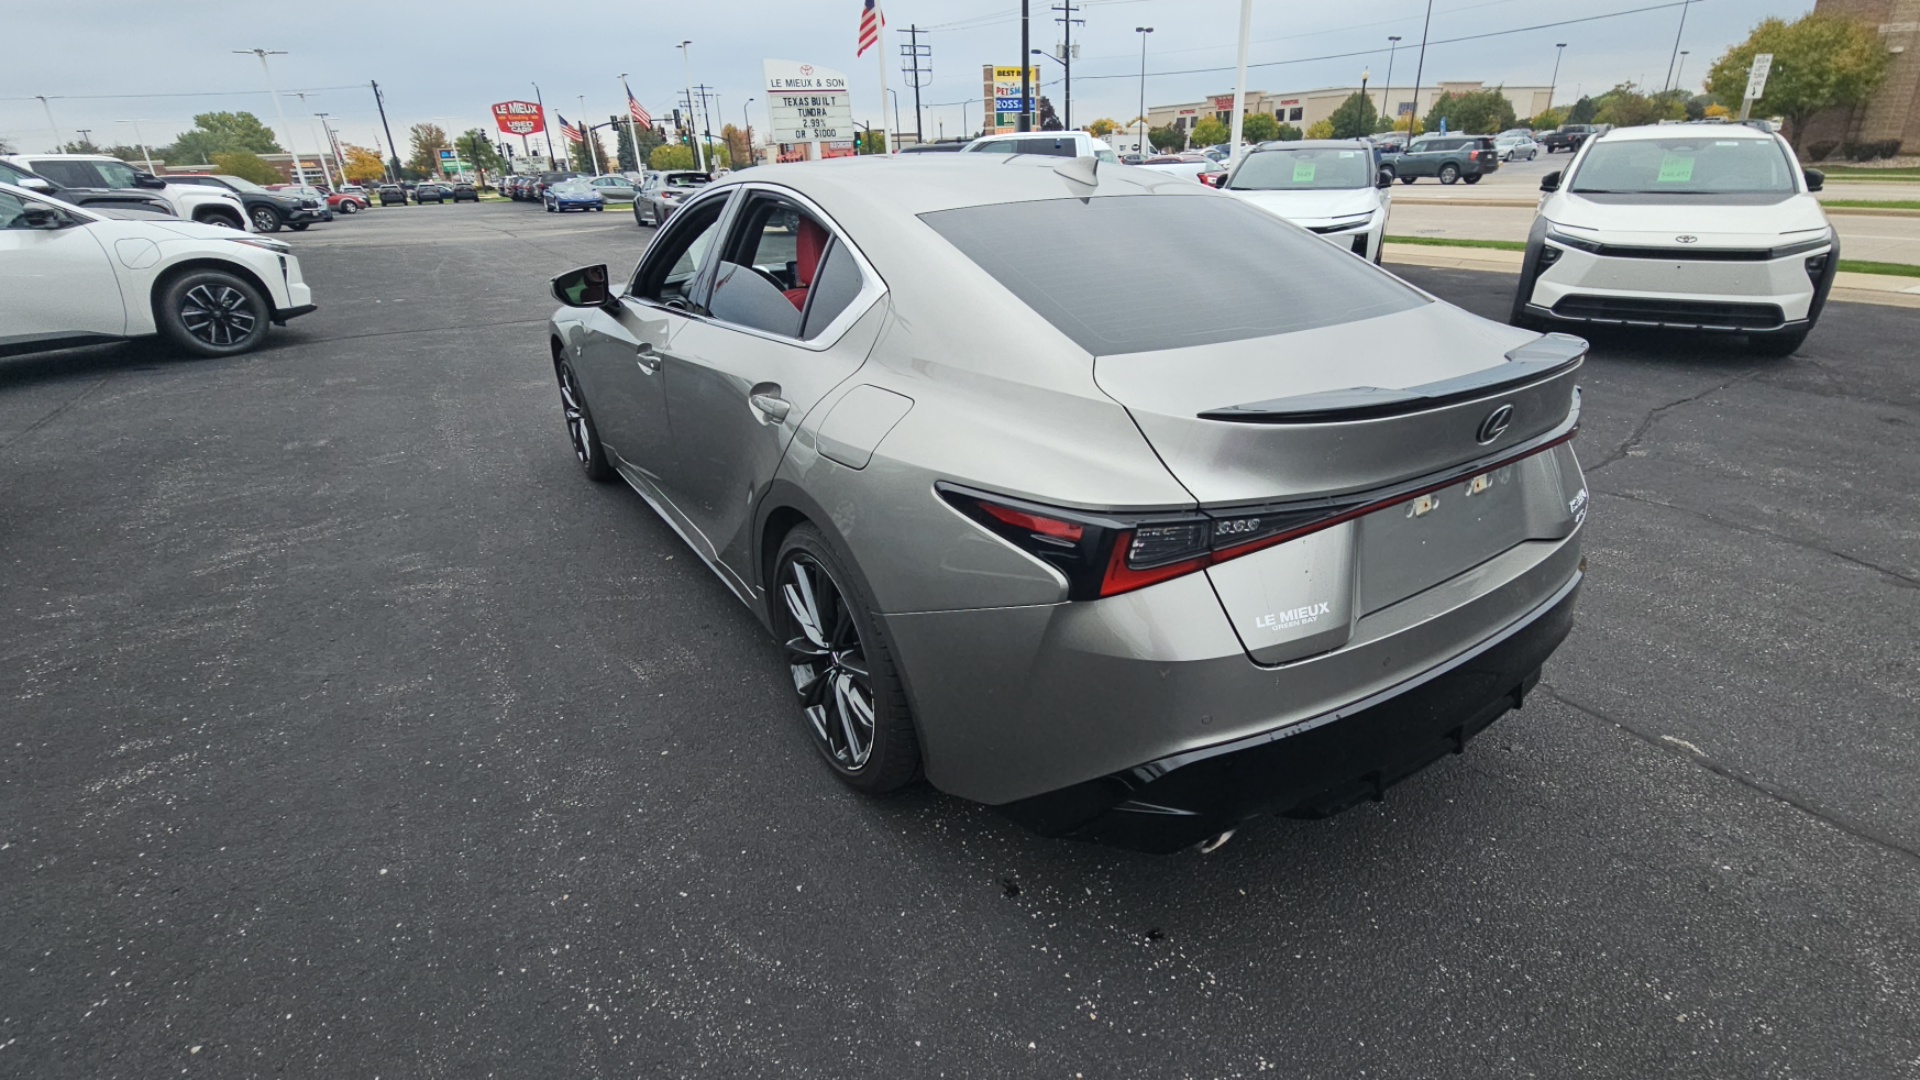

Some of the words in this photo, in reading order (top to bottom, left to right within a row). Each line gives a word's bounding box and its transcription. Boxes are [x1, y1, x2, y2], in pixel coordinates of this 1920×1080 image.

[771, 79, 782, 87] LE
[785, 79, 812, 87] MIEUX
[816, 79, 822, 87] &
[826, 79, 844, 87] SON
[996, 87, 1034, 95] PETSMT
[783, 97, 809, 106] TEXAS
[811, 97, 836, 106] BUILT
[996, 100, 1018, 108] ROSS
[496, 105, 507, 114] LE
[508, 102, 538, 114] MIEUX
[797, 108, 827, 117] TUNDRA
[803, 119, 826, 128] 2.99%
[796, 130, 806, 138] OR
[1255, 614, 1276, 628] LE
[1280, 602, 1330, 623] MIEUX
[1272, 620, 1299, 630] GREEN
[1301, 616, 1318, 624] BAY
